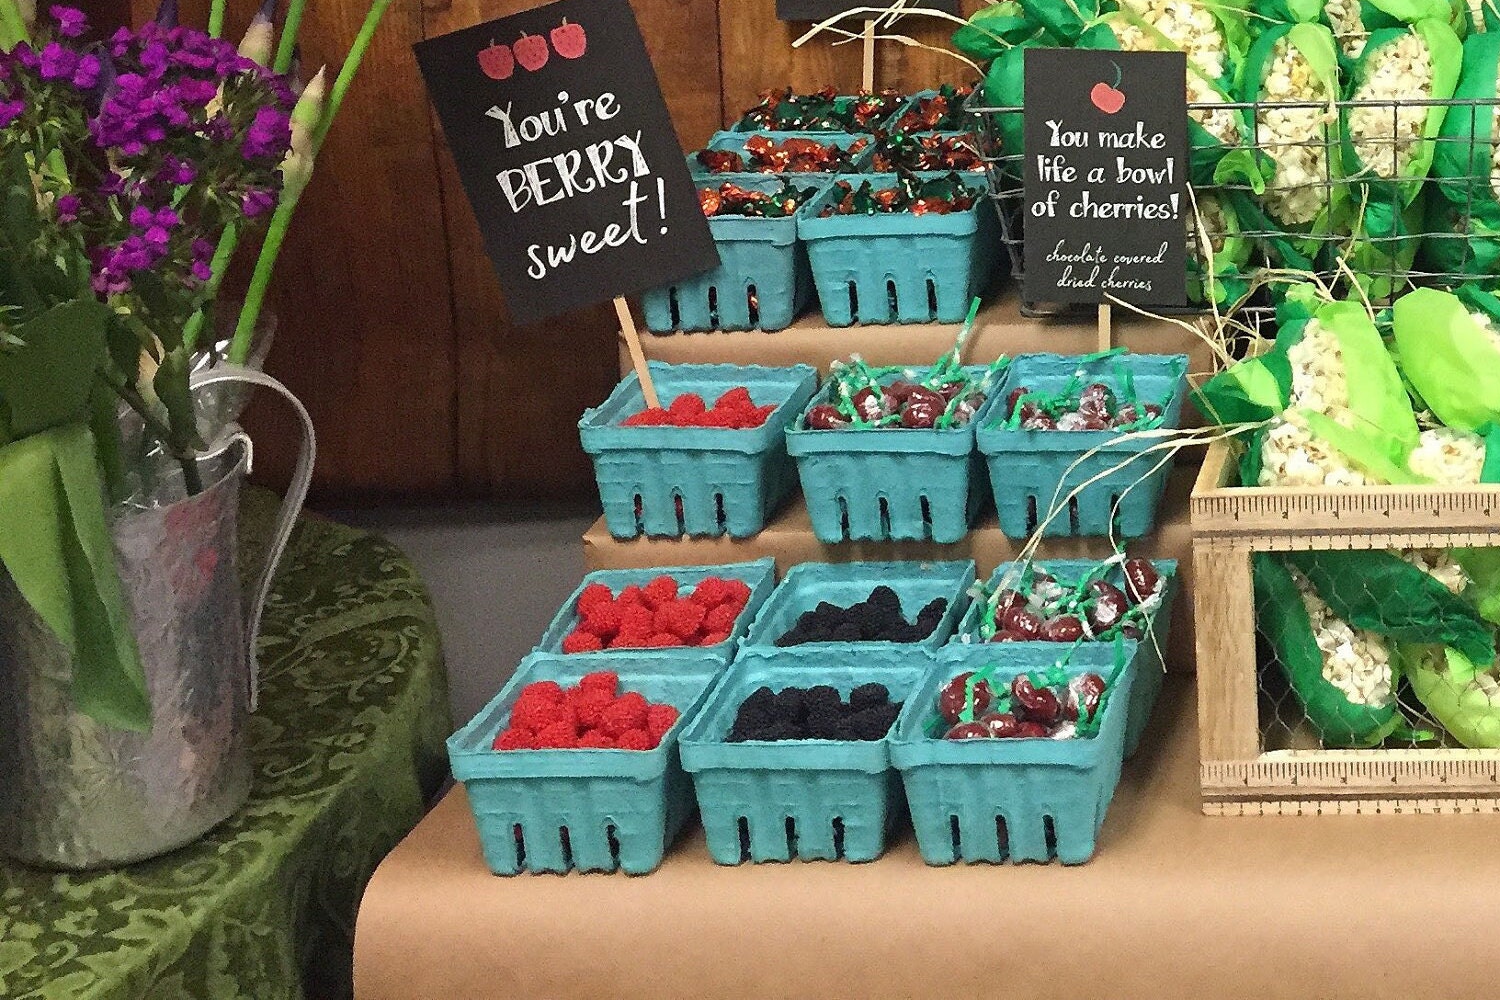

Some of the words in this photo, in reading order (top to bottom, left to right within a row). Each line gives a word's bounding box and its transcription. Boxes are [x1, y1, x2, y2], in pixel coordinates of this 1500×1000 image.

[485, 90, 621, 149] You're
[1045, 119, 1088, 147] You
[1098, 121, 1165, 148] make
[495, 129, 650, 213] BERRY
[1037, 154, 1077, 182] life
[1087, 167, 1105, 183] a
[1115, 156, 1173, 184] bowl
[1030, 189, 1059, 217] of
[1069, 190, 1179, 219] cherries!
[526, 176, 668, 279] sweet!
[1045, 239, 1107, 263] chocolate
[1113, 241, 1168, 264] covered
[1056, 264, 1097, 288] dried
[1100, 265, 1151, 291] cherries
